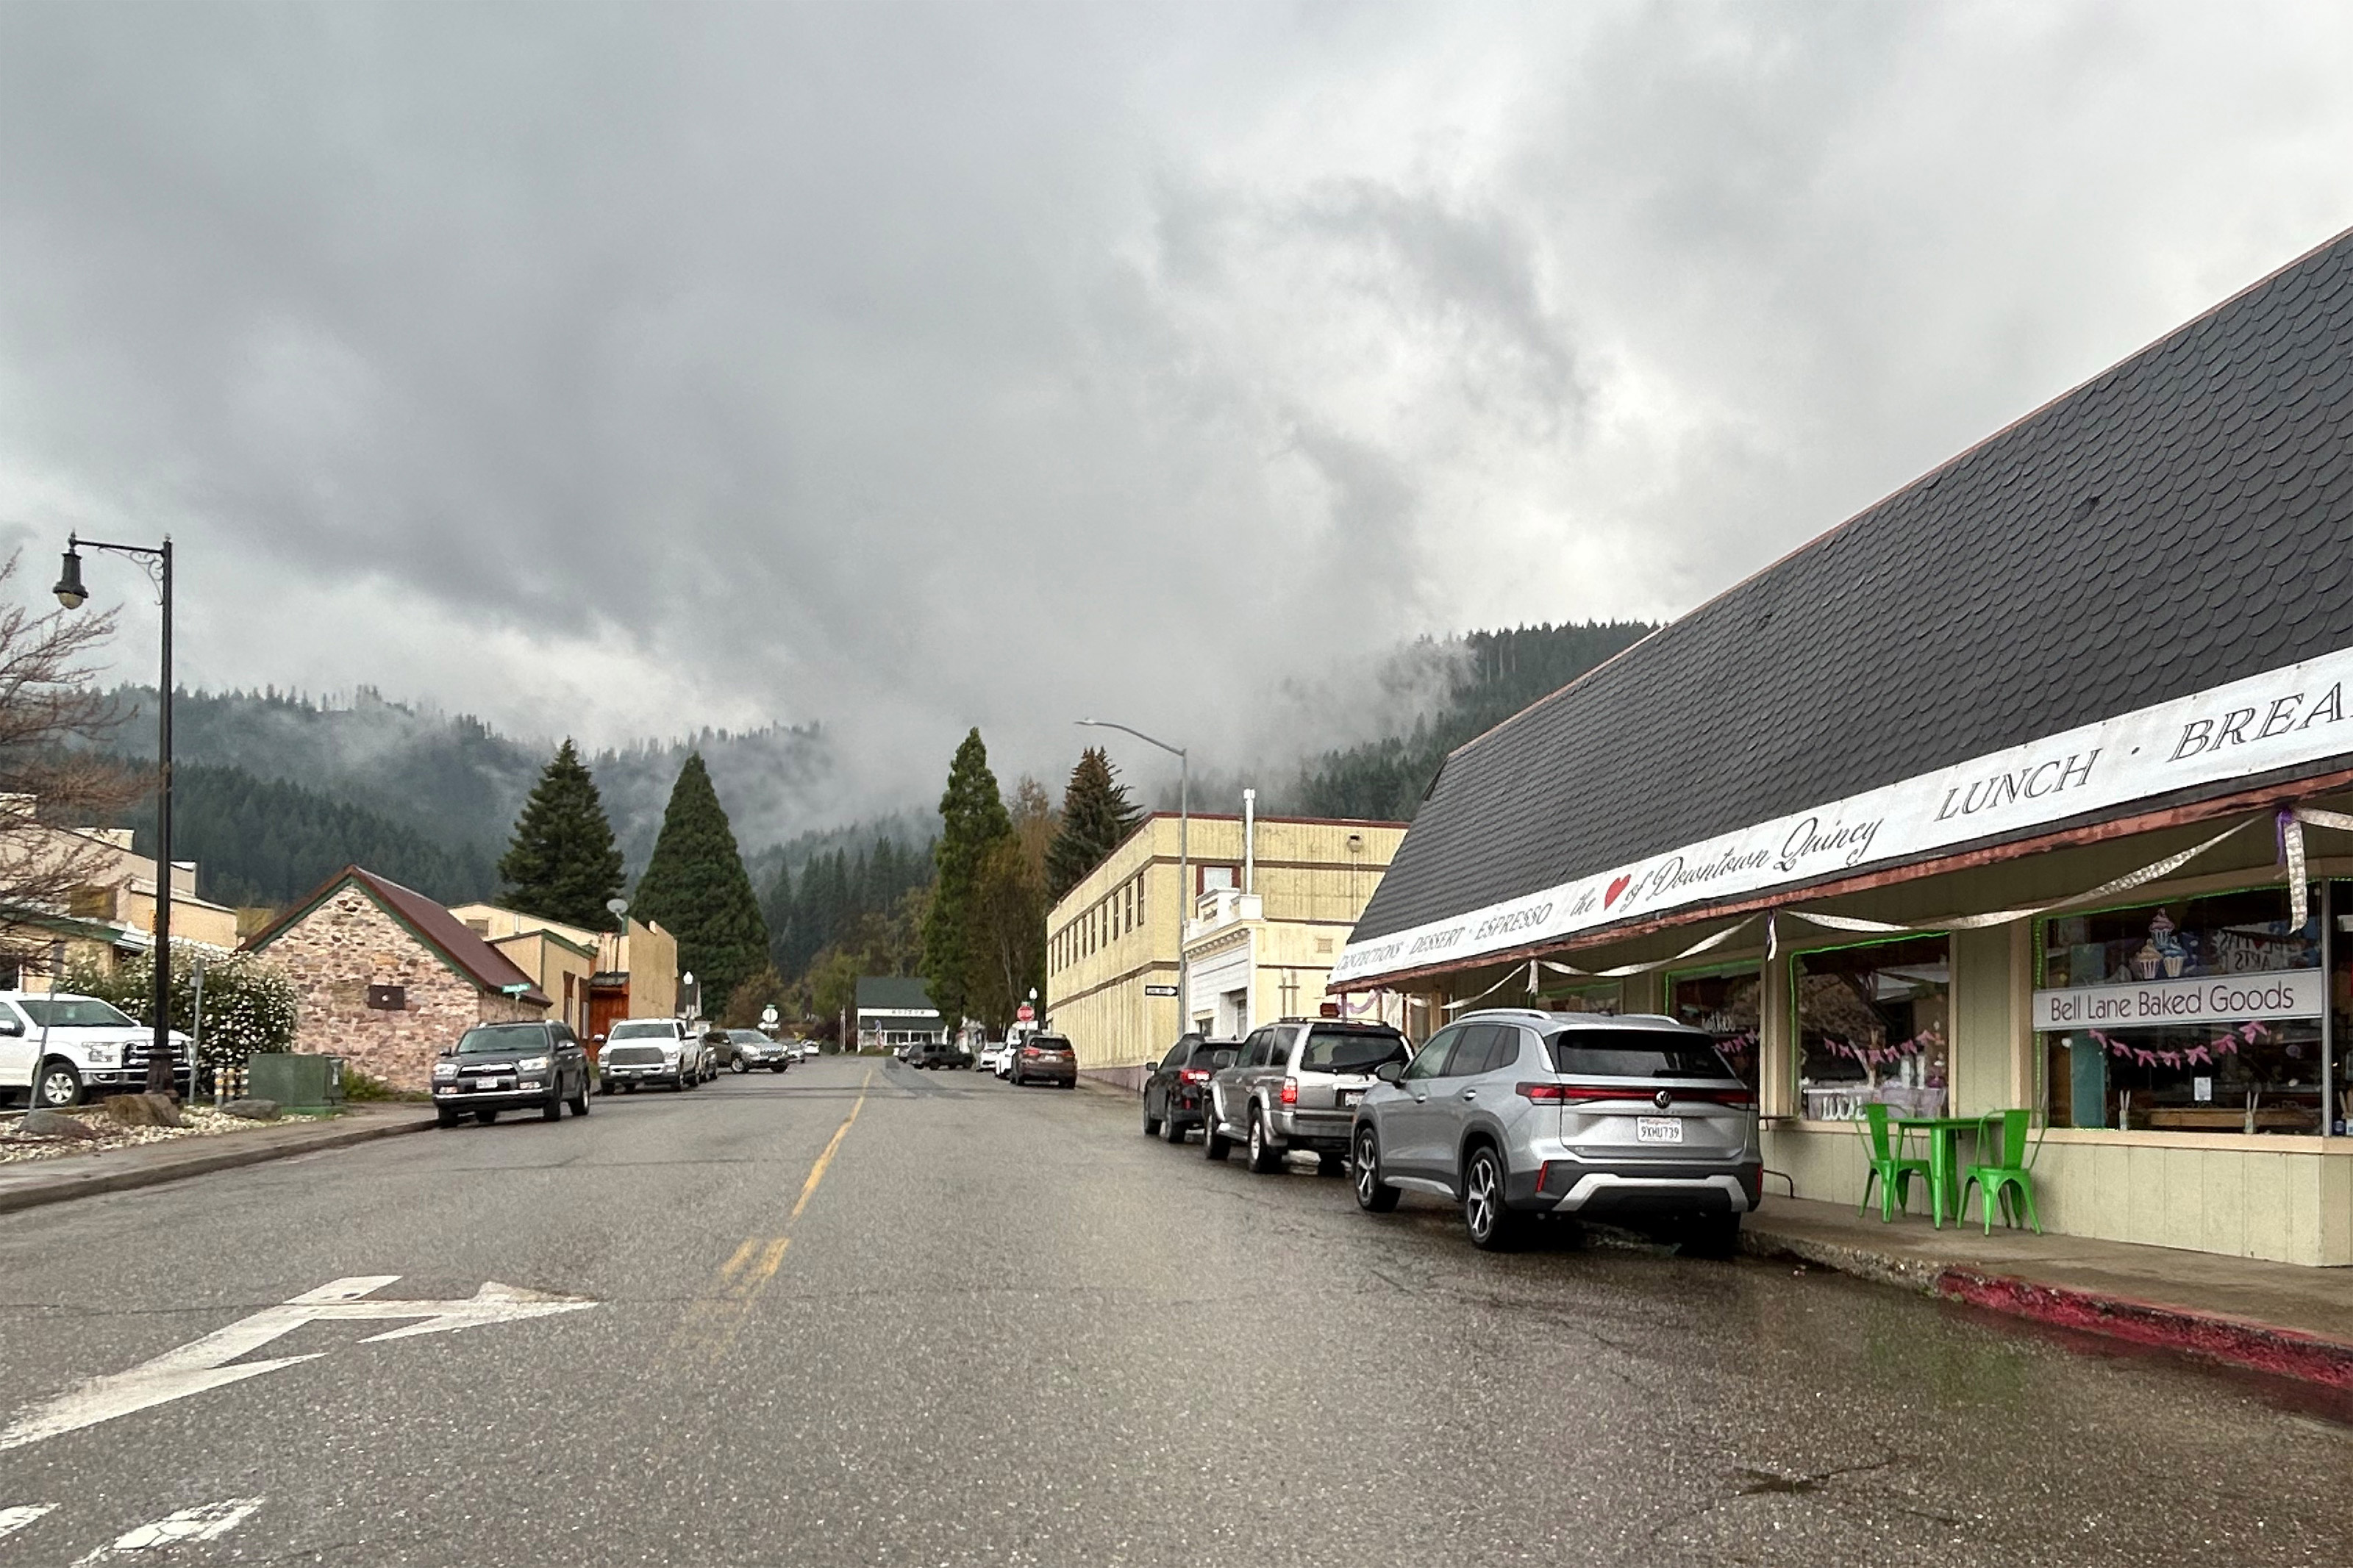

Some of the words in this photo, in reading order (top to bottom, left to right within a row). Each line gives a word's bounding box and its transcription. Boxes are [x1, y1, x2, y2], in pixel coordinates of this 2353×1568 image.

[1409, 927, 1465, 955] DESSERT
[1474, 902, 1553, 940] ESPRESSO
[1570, 884, 1596, 916] the
[1619, 870, 1652, 913] of
[1646, 847, 1770, 901] Downtown
[1773, 817, 1884, 867] Quincy
[1933, 748, 2103, 823] LUNCH
[2165, 681, 2353, 762] BREA
[2051, 995, 2080, 1021] Bell
[2087, 995, 2131, 1019] Lane
[2138, 987, 2202, 1016] Baked
[2210, 980, 2293, 1012] Goods
